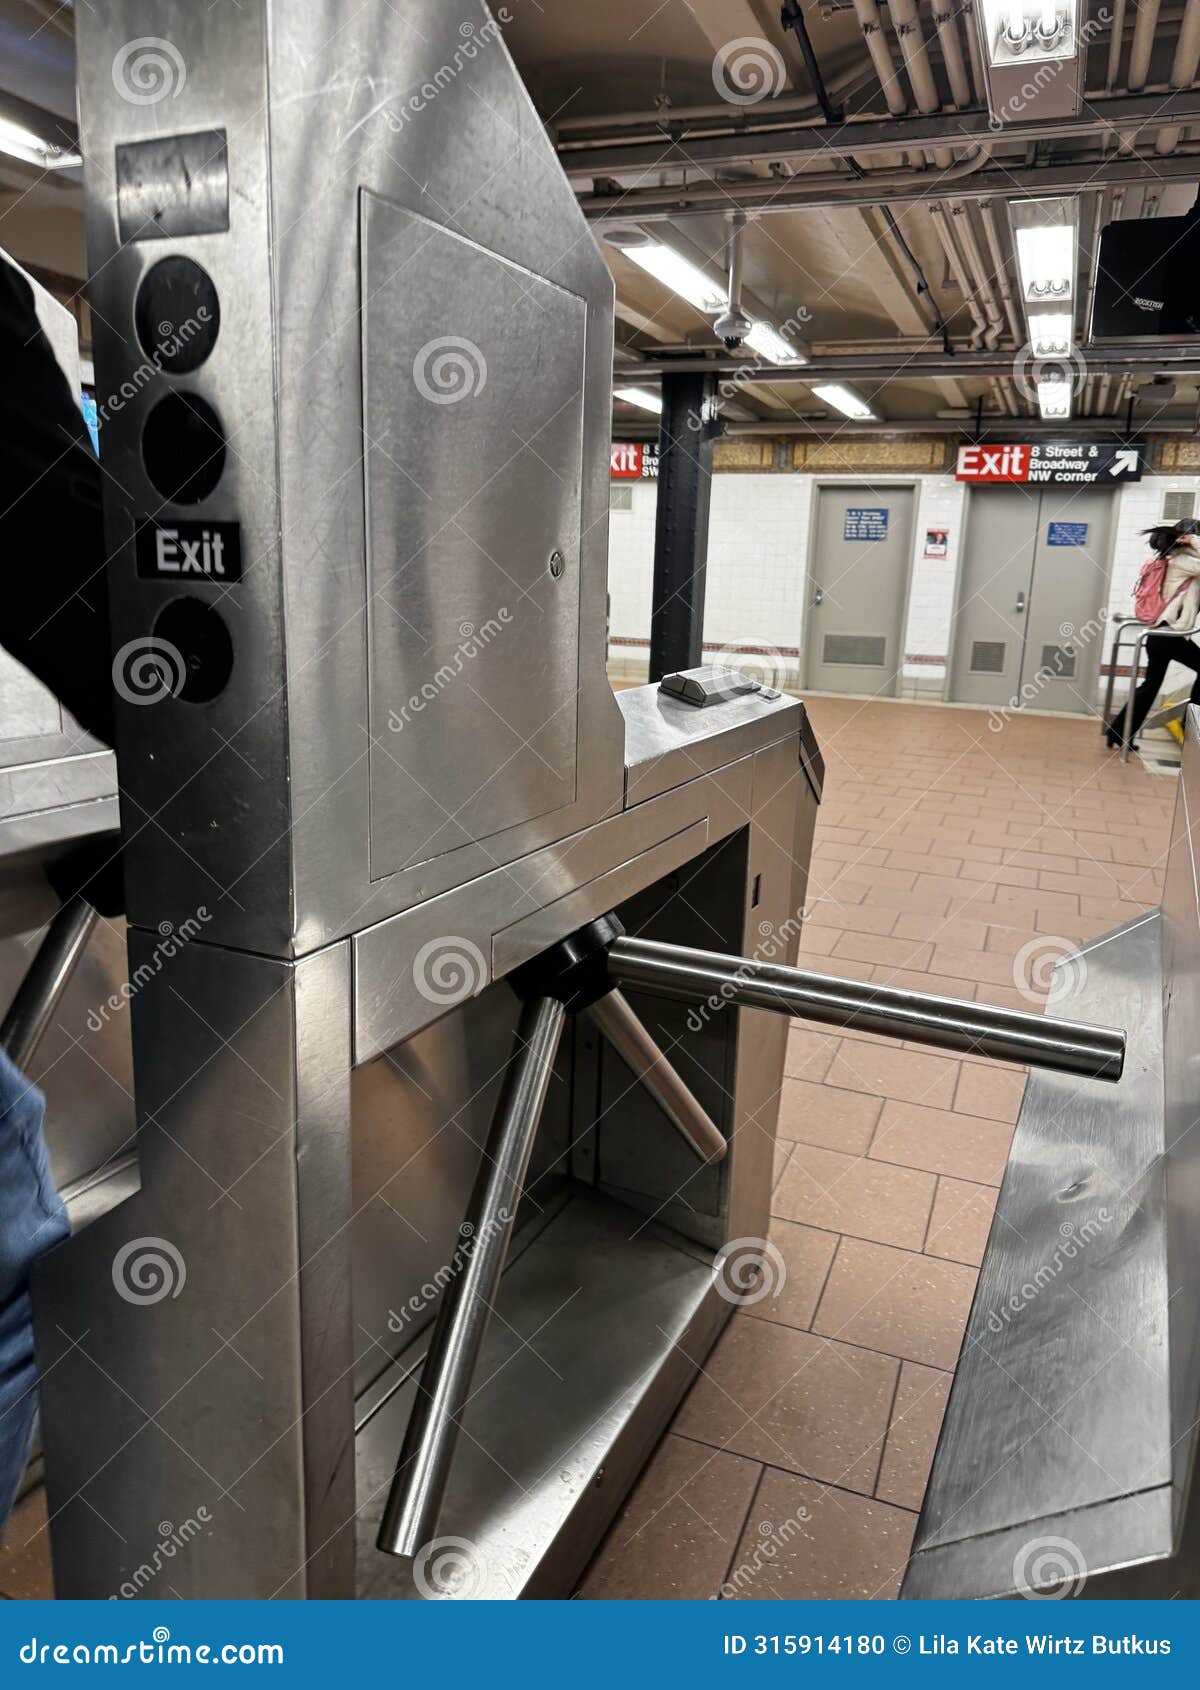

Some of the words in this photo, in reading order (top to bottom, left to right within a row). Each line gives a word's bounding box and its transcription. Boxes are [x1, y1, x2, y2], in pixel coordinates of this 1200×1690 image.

[1031, 446, 1040, 457] 8
[1045, 446, 1083, 457] Street
[1088, 446, 1099, 457] &
[956, 446, 1024, 475] Exit
[1029, 458, 1090, 470] Broadway
[1028, 471, 1051, 481] NW
[1055, 472, 1098, 482] corner
[156, 530, 226, 575] Exit
